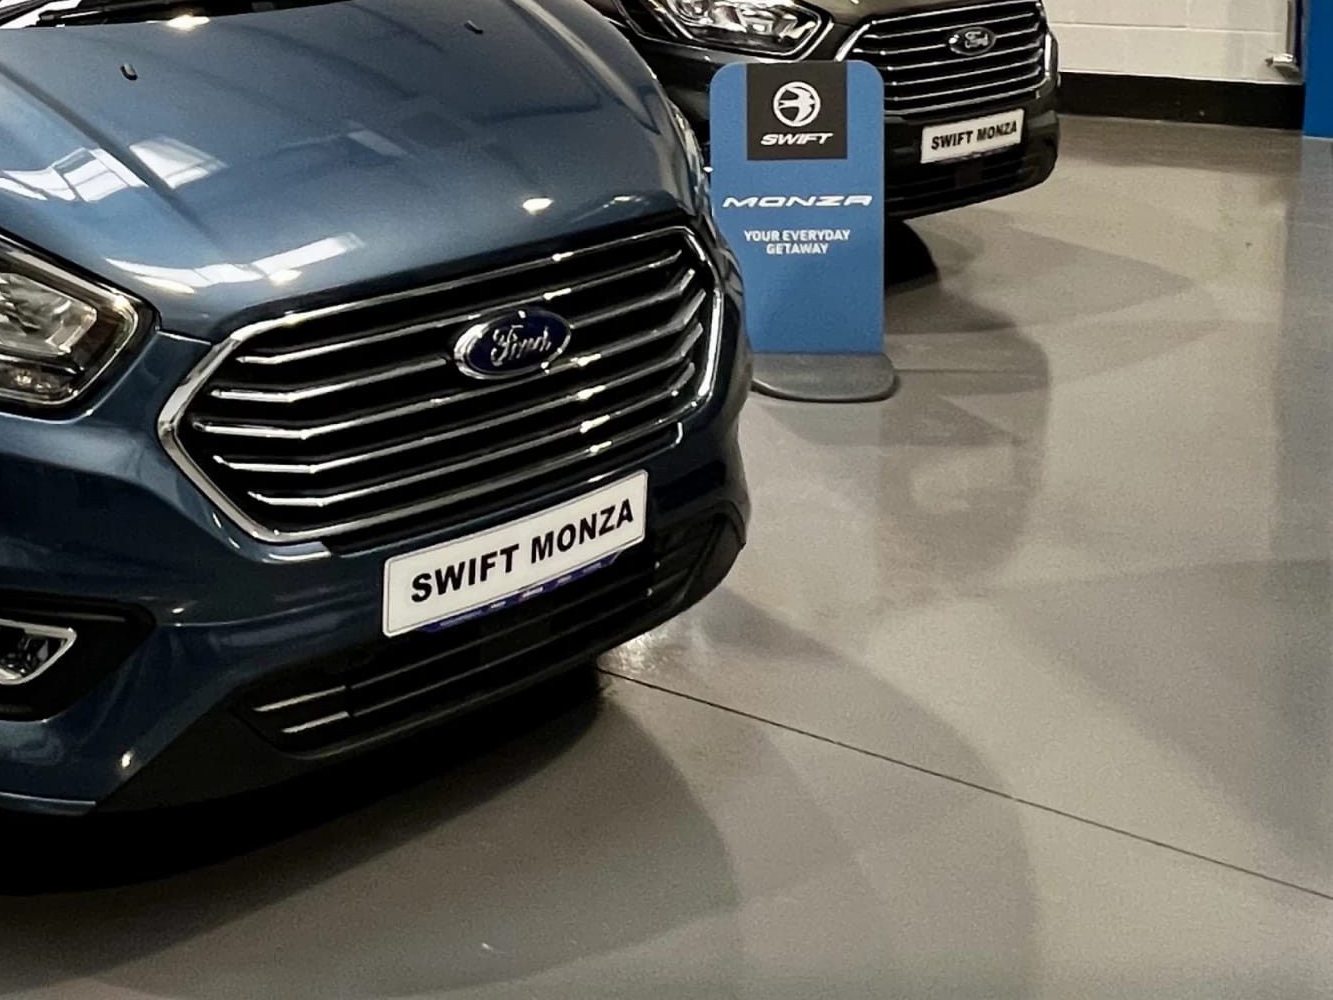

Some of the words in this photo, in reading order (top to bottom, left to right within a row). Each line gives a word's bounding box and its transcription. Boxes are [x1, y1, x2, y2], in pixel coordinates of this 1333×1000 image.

[760, 132, 834, 146] SWIFT
[931, 131, 974, 150] SWIFT
[977, 121, 1017, 141] MONZA
[722, 195, 873, 207] MONZA
[744, 230, 780, 242] YOUR
[782, 229, 851, 241] EVERYDAY
[766, 243, 829, 255] GETAWAY
[490, 324, 552, 366] Ford
[411, 544, 520, 603] SWIFT
[530, 498, 634, 564] MONZA
